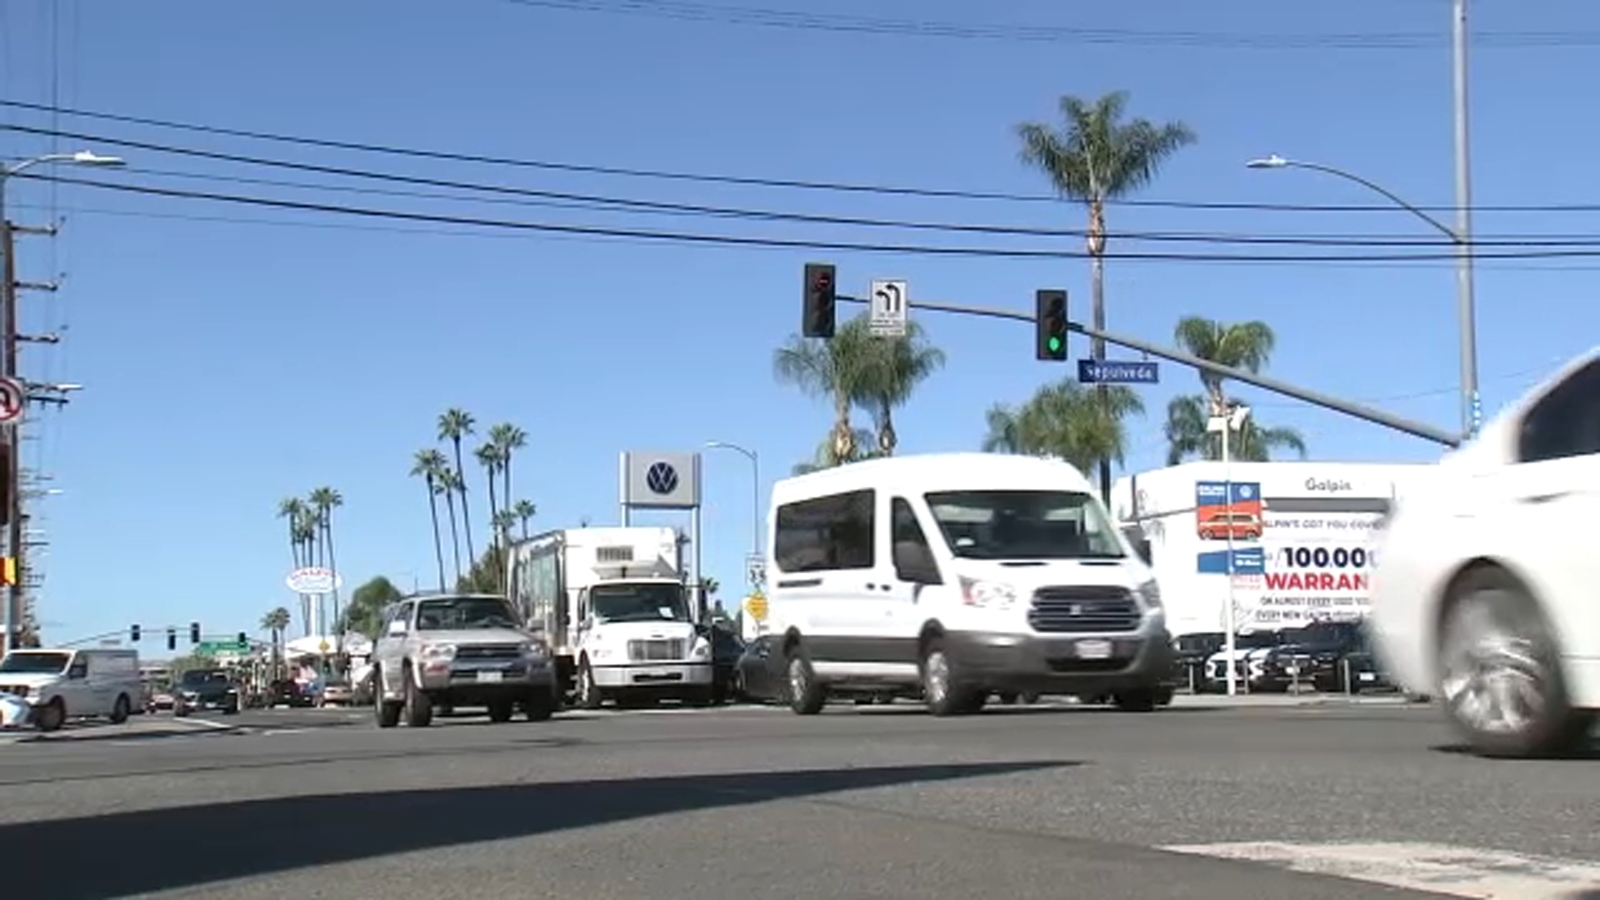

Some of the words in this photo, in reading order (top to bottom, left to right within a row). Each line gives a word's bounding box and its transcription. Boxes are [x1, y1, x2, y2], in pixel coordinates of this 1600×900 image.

[1086, 365, 1153, 380] Sepulveda
[1304, 477, 1352, 493] Galpin
[1326, 519, 1348, 529] YOU
